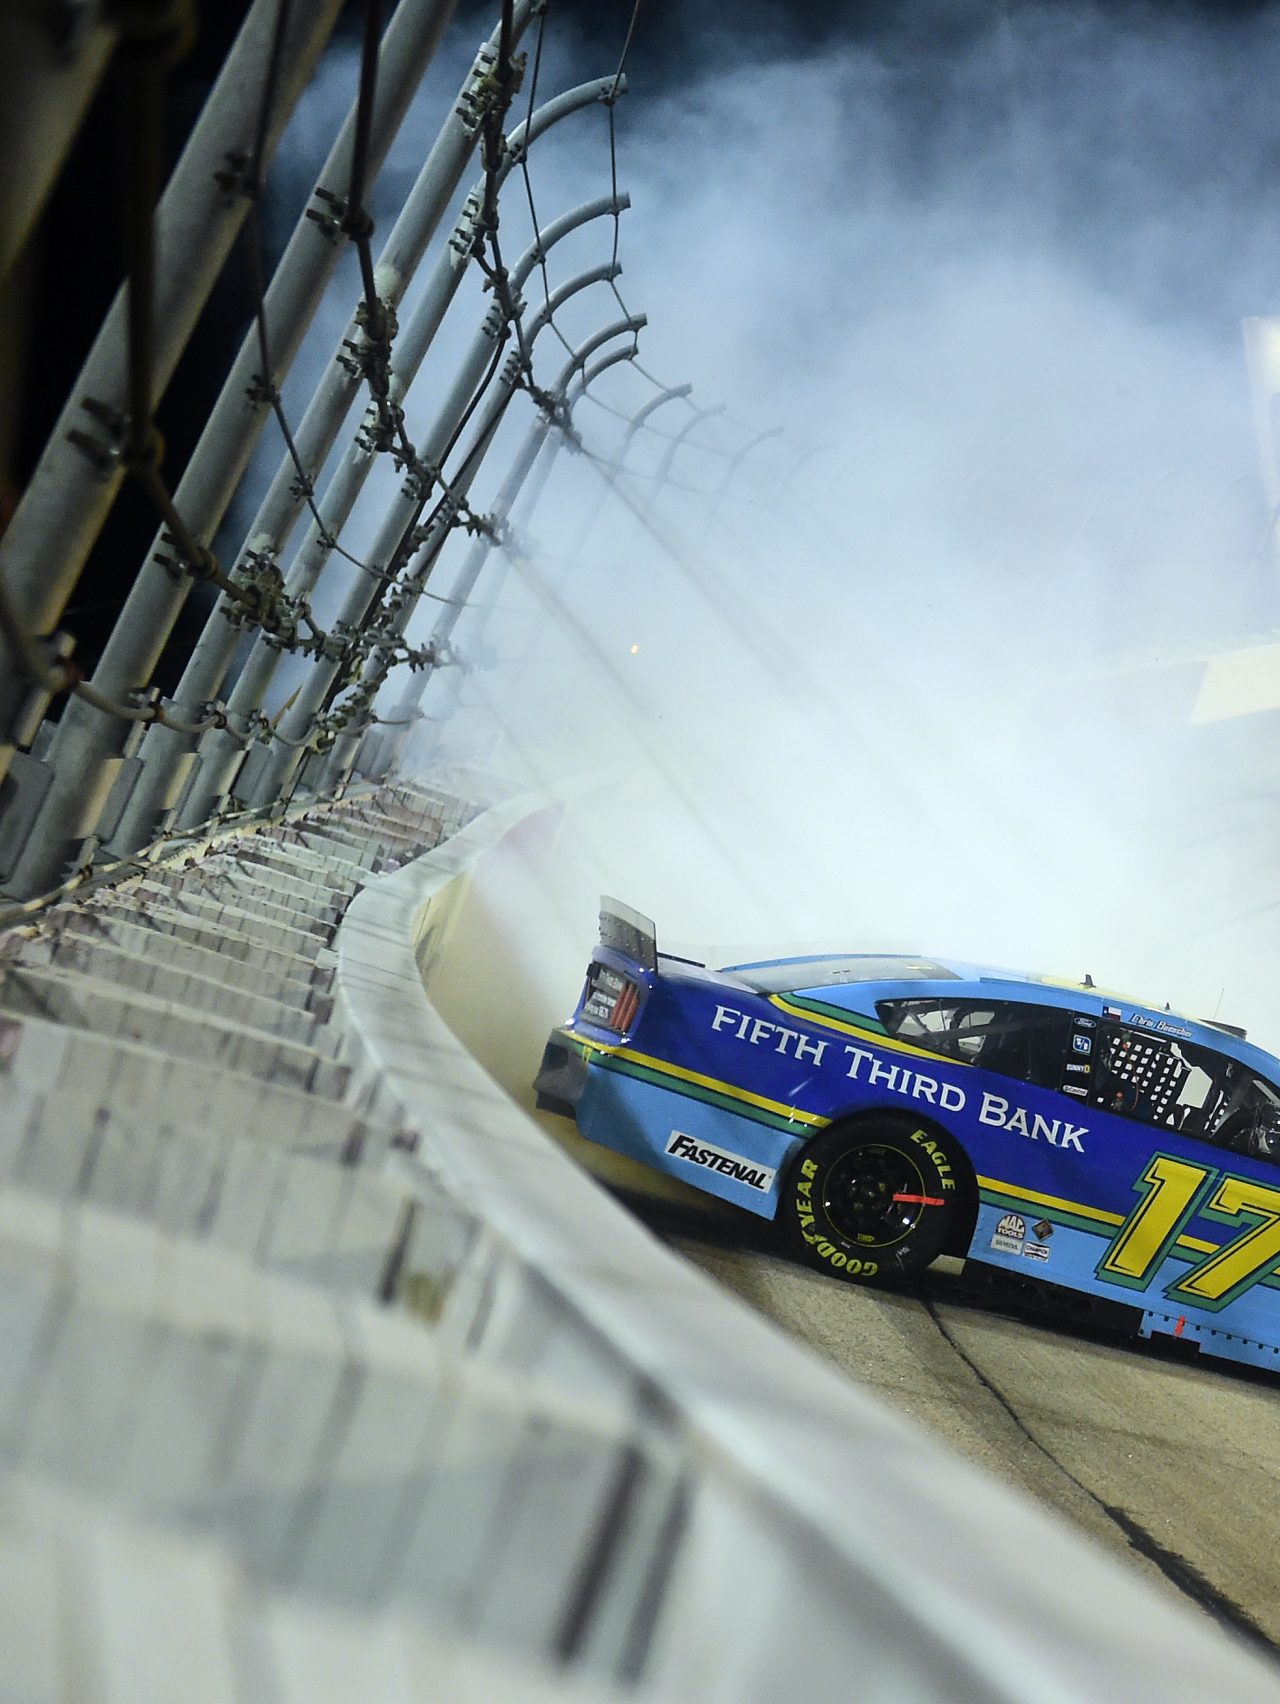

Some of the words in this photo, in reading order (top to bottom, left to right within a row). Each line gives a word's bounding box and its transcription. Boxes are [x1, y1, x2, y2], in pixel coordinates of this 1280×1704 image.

[1076, 1017, 1094, 1027] Ford
[1130, 1014, 1153, 1027] Chris
[711, 1005, 830, 1066] FIFTH
[844, 1045, 966, 1112] THIRD
[979, 1091, 1089, 1153] BANK
[667, 1134, 768, 1190] FASTENAL
[910, 1129, 956, 1190] EAGLE
[796, 1159, 878, 1276] GOODYEAR
[999, 1215, 1024, 1233] MAC
[997, 1228, 1024, 1239] TOOLS
[1026, 1245, 1048, 1255] CHAMPION
